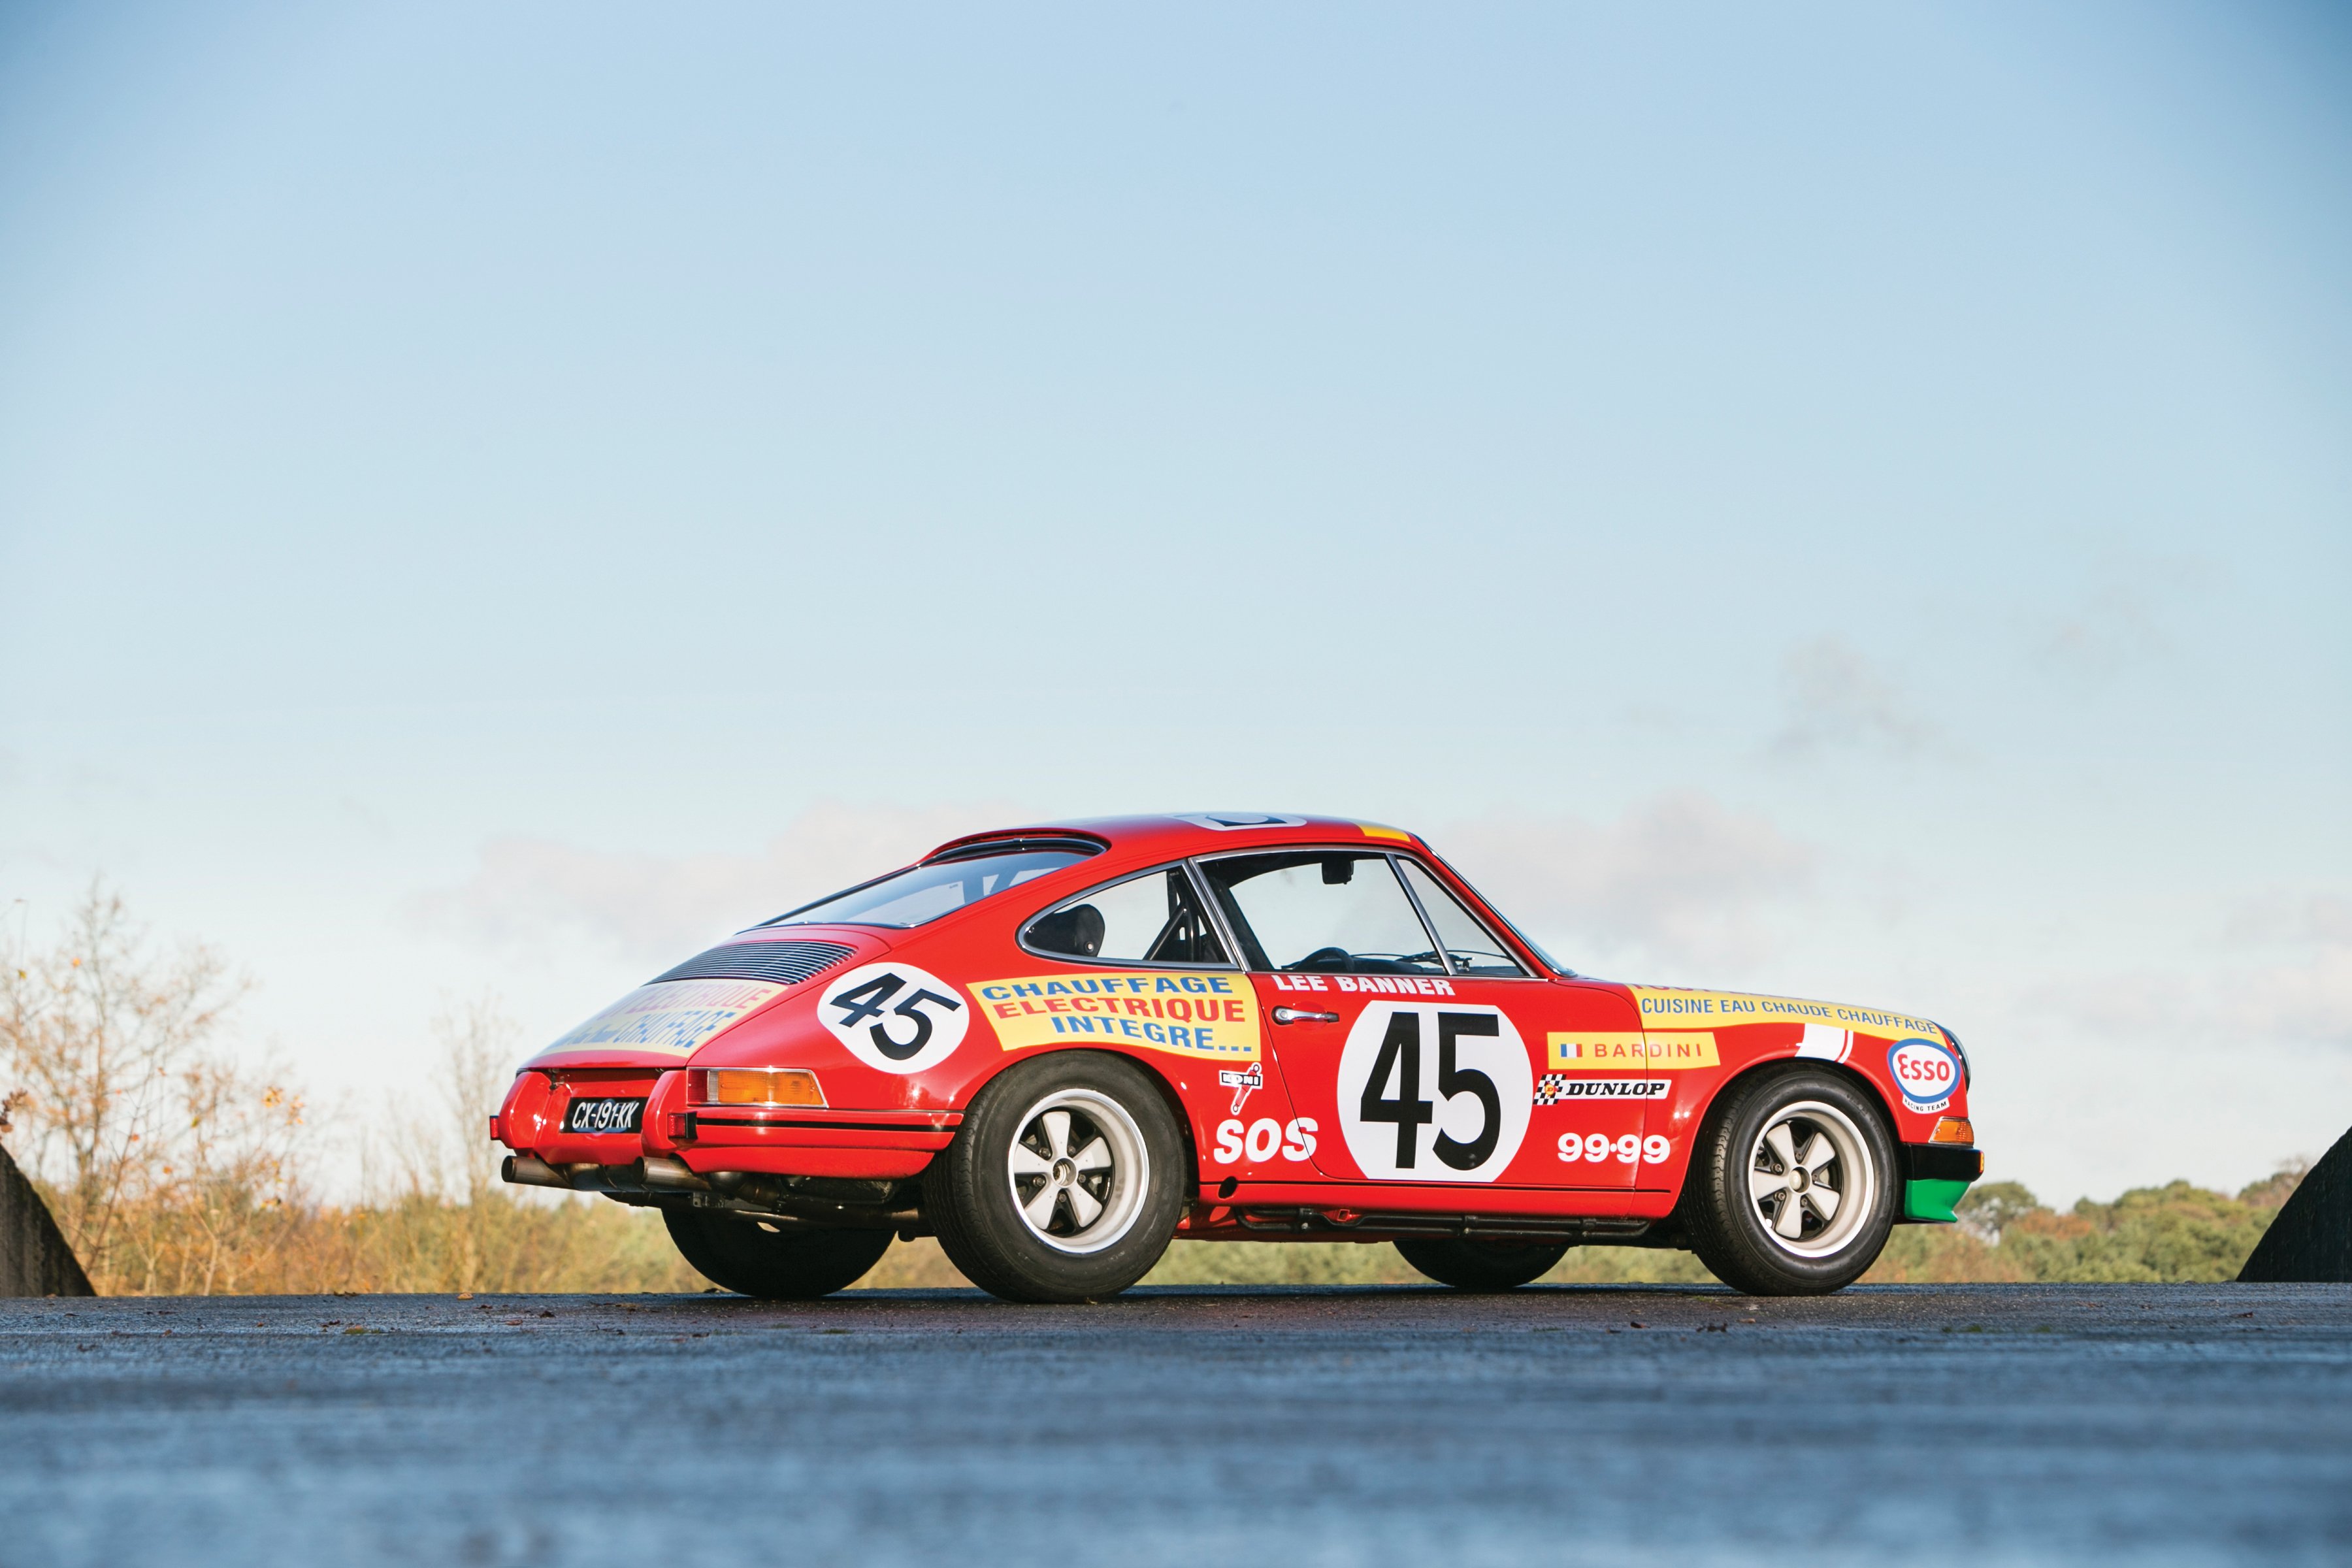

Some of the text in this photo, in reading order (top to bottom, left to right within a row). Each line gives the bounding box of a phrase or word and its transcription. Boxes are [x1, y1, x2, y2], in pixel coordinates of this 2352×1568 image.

[982, 977, 1233, 1000] CHAUFFAGE
[1271, 975, 1456, 996] LEE BANNER
[830, 972, 962, 1060] 45
[992, 998, 1245, 1022] ELECTRIQUE
[1642, 998, 1937, 1034] CUISINE EAU CHAUDE CHAUFFAGE
[613, 1010, 736, 1047] CHAUFFAGE
[1051, 1016, 1252, 1052] INTEGRE...
[1595, 1043, 1701, 1057] BARDINI
[1360, 1011, 1501, 1171] 45
[1566, 1083, 1665, 1096] DUNLOP
[572, 1102, 640, 1129] CX-191-KK
[1904, 1098, 1946, 1111] RACING TEAM
[1214, 1117, 1318, 1164] SOS
